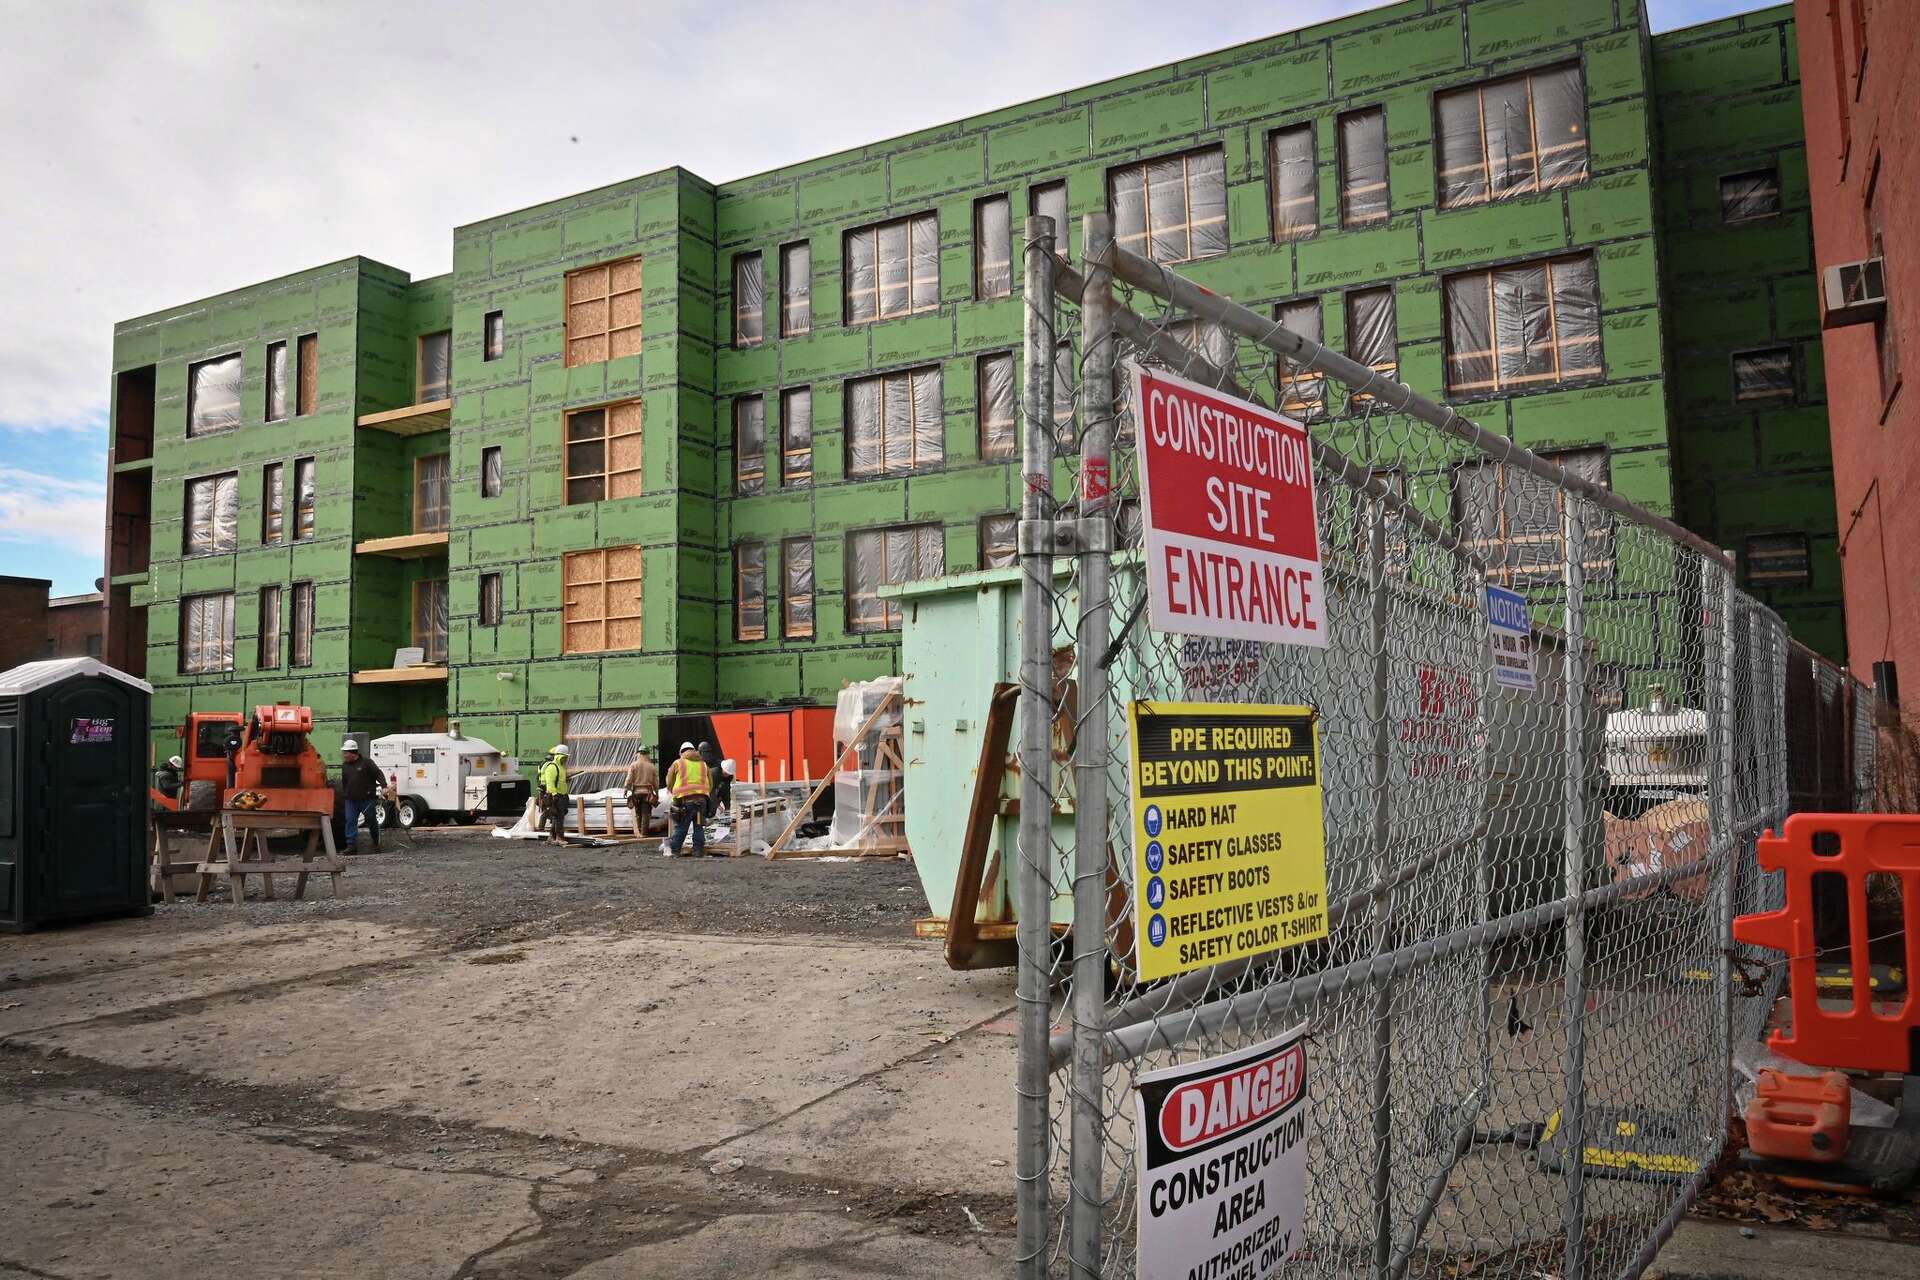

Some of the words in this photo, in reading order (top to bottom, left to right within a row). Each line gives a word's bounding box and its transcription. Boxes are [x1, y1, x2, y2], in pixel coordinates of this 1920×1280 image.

[1150, 388, 1307, 488] CONSTRUCTION
[1206, 476, 1275, 543] SITE
[1165, 545, 1317, 631] ENTRANCE
[1489, 595, 1527, 629] NOTICE
[1170, 727, 1207, 751] PPE
[1212, 727, 1292, 752] REQUIRED
[1141, 760, 1219, 787] BEYOND
[1224, 757, 1263, 782] THIS
[1267, 756, 1313, 779] POINT:
[1166, 807, 1206, 830] HARD
[1211, 804, 1237, 826] HAT
[1168, 840, 1222, 866] SAFETY
[1227, 832, 1282, 858] GLASSES
[1169, 874, 1224, 900] SAFETY
[1228, 866, 1270, 890] BOOTS
[1170, 903, 1253, 938] REFLECTIVE
[1256, 894, 1294, 919] VESTS
[1297, 892, 1319, 911] &/or
[1179, 935, 1232, 965] SAFETY
[1237, 924, 1278, 951] COLOR
[1281, 914, 1323, 940] T-SHIRT
[1180, 1051, 1297, 1144] DANGER
[1150, 1106, 1305, 1218] CONSTRUCTION
[1212, 1180, 1266, 1239] AREA
[1260, 1229, 1292, 1272] ONLY
